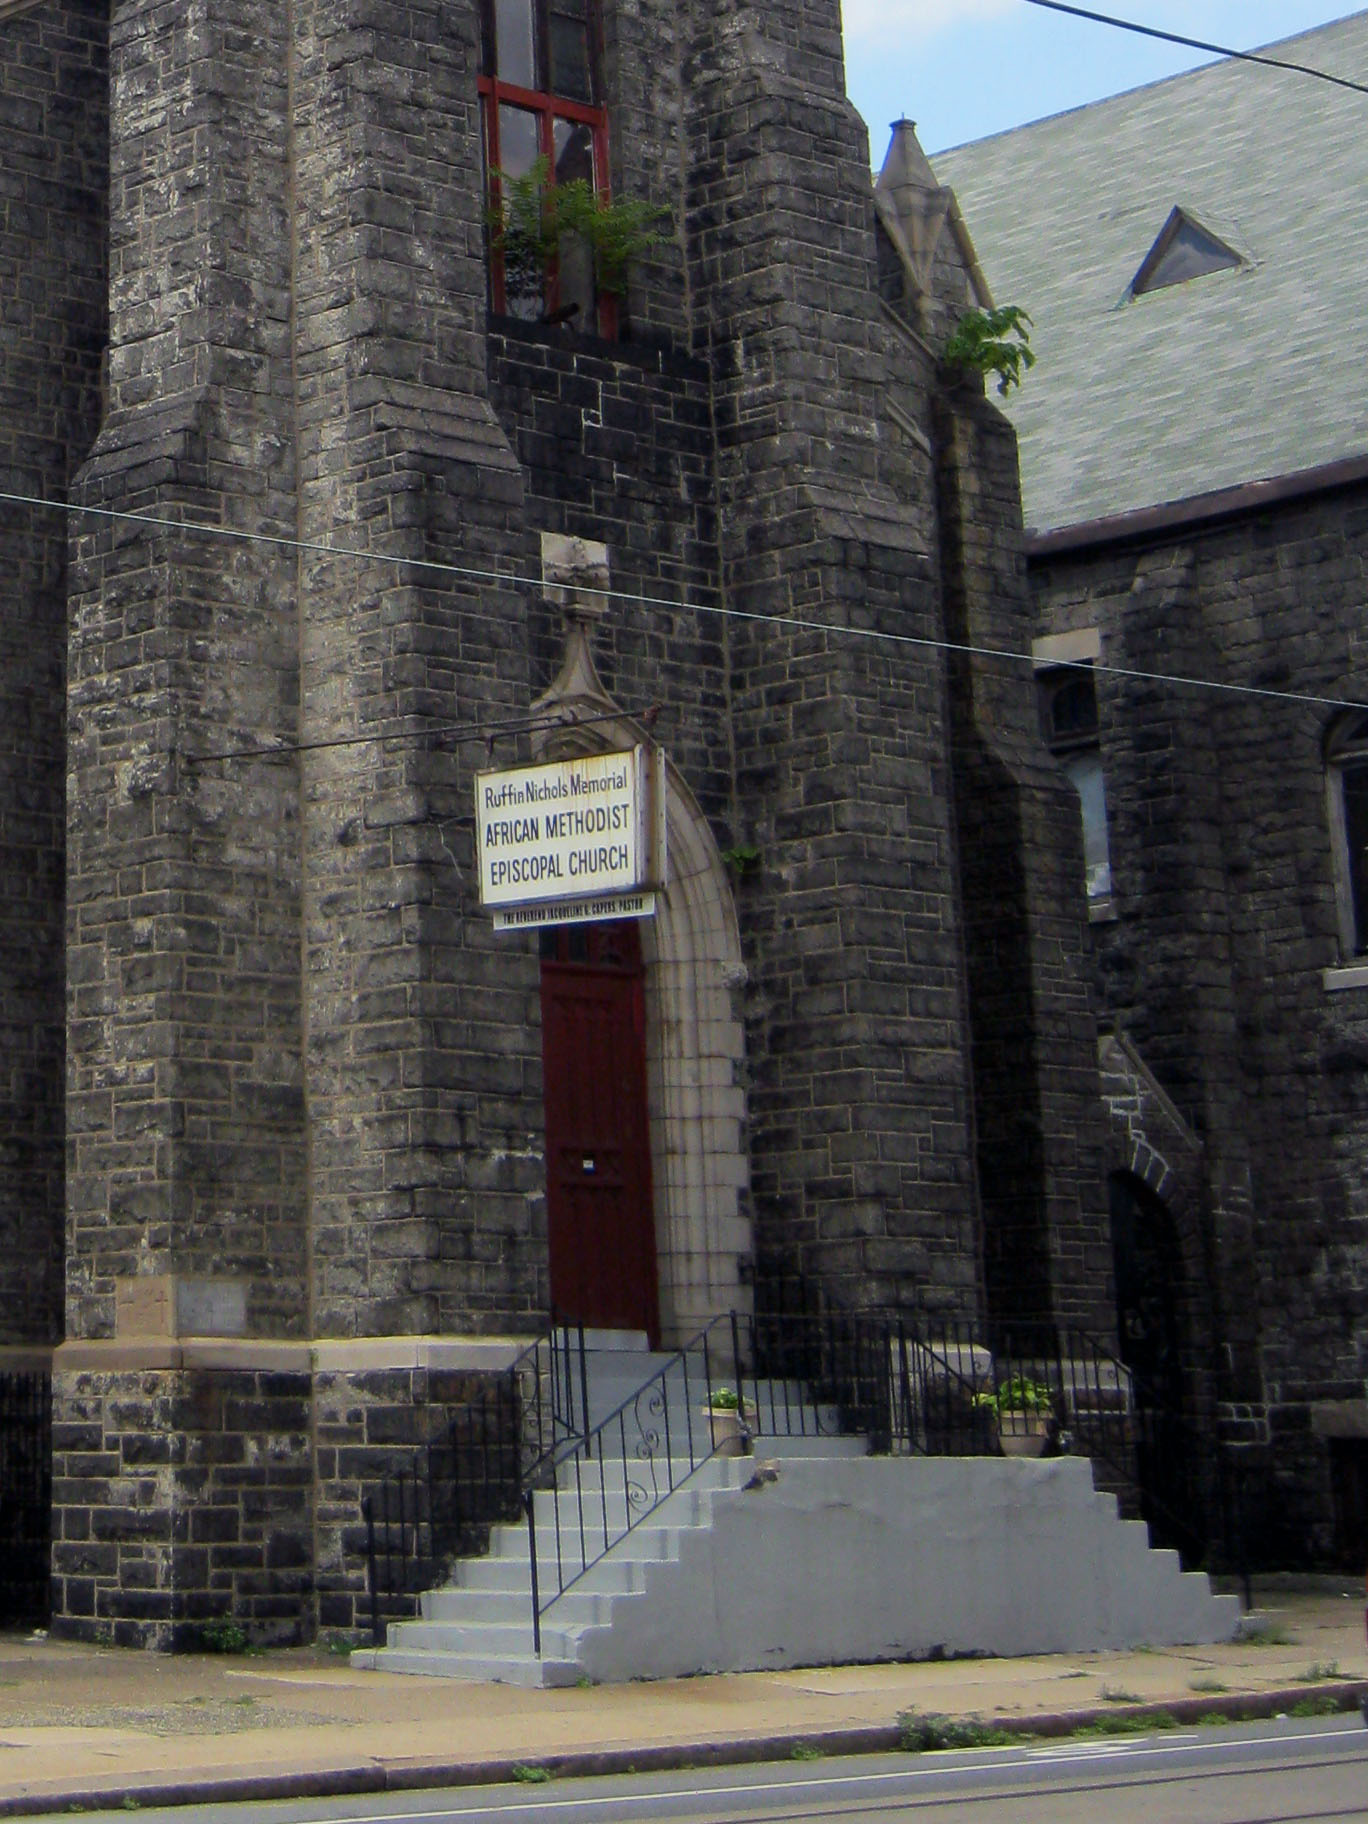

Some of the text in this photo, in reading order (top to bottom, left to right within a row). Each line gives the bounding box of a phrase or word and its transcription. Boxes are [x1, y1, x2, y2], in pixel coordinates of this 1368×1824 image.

[485, 766, 627, 809] Ruffin Nichols Memorial
[486, 803, 629, 848] AFRICAN METHODIST
[490, 844, 628, 886] EPISCOPAL CHURCH
[504, 912, 514, 925] THE
[516, 907, 546, 924] REVEREND
[547, 904, 583, 921] JACQUELINE
[619, 897, 643, 912] PASTOR
